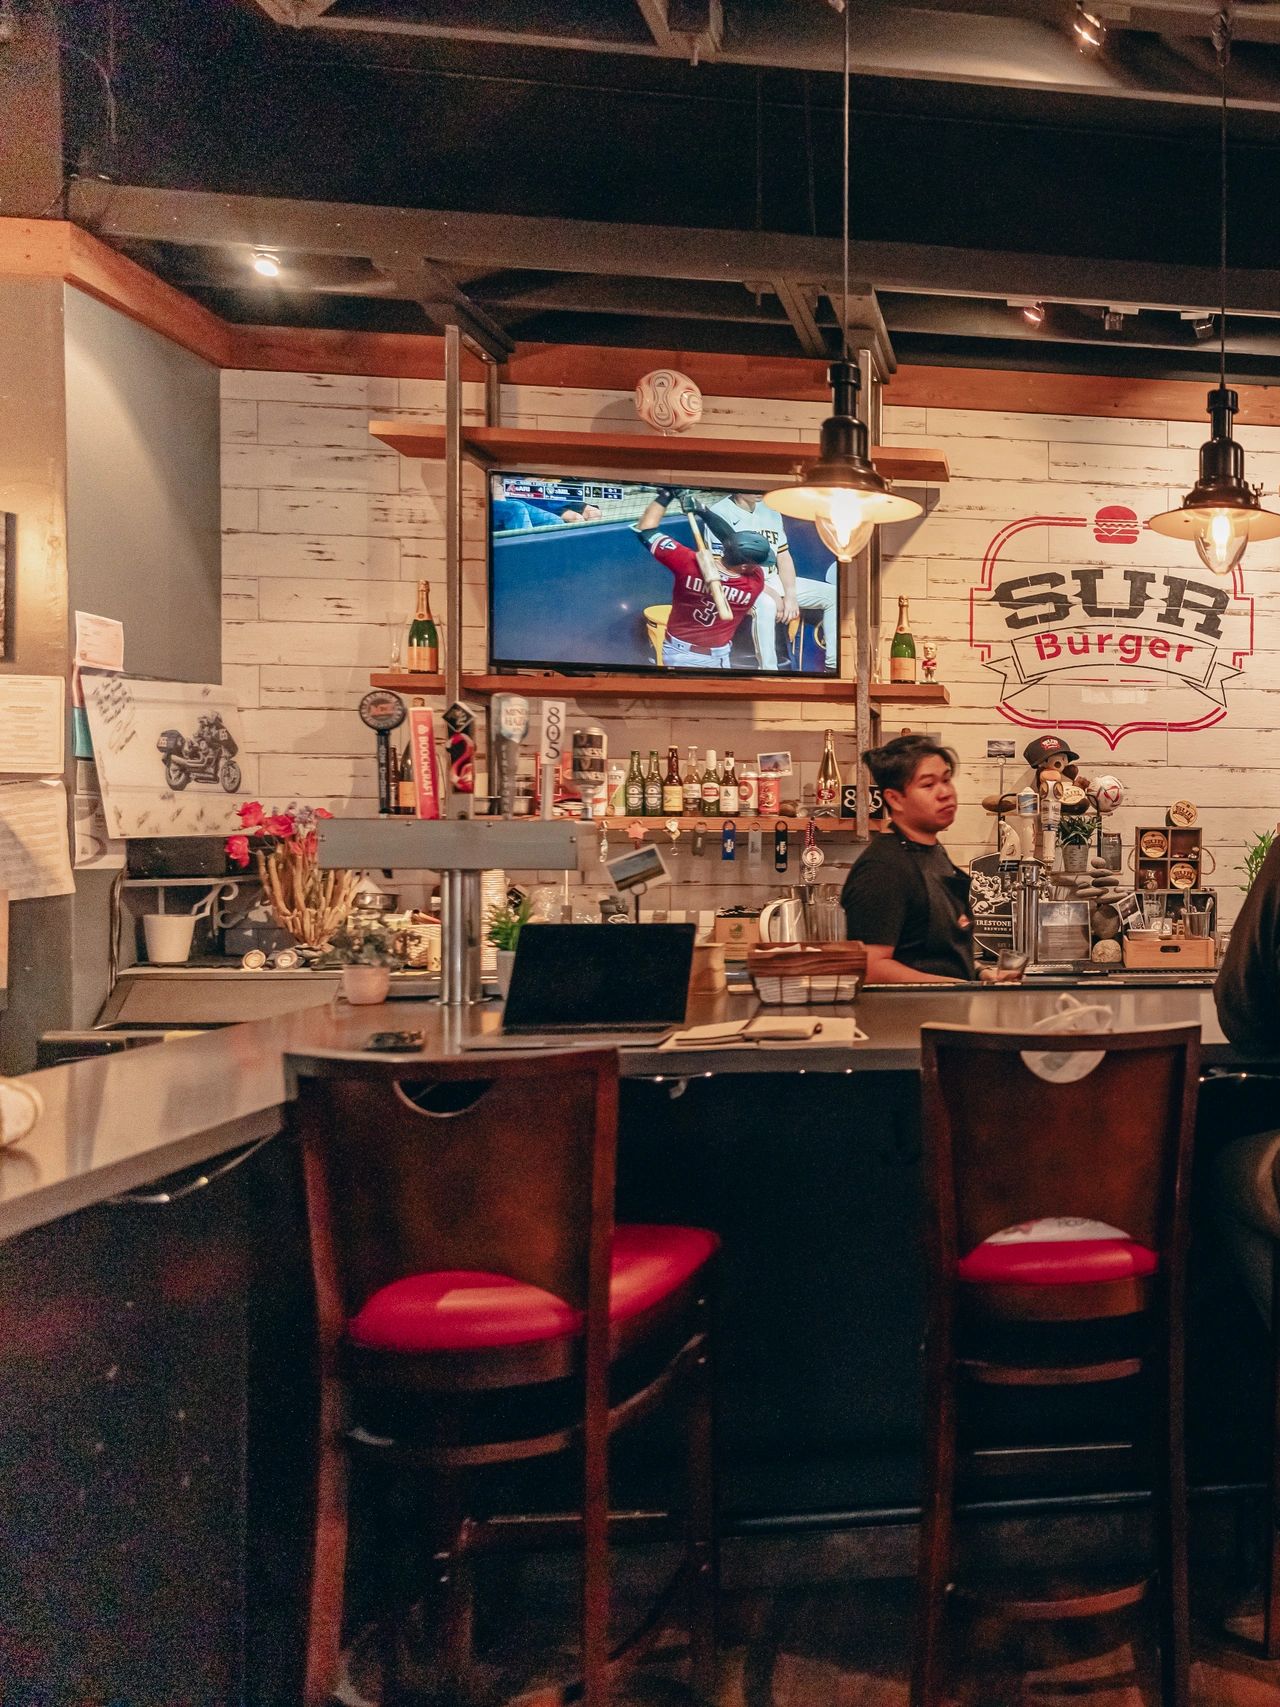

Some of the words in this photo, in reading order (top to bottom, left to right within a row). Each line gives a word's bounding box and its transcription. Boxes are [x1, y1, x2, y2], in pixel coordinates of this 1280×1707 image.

[685, 575, 752, 605] LONORIA
[990, 569, 1230, 640] SUR
[1034, 632, 1194, 664] Burger
[546, 706, 560, 759] 805
[418, 736, 433, 796] BOOCHCRAFT
[844, 788, 883, 809] 85
